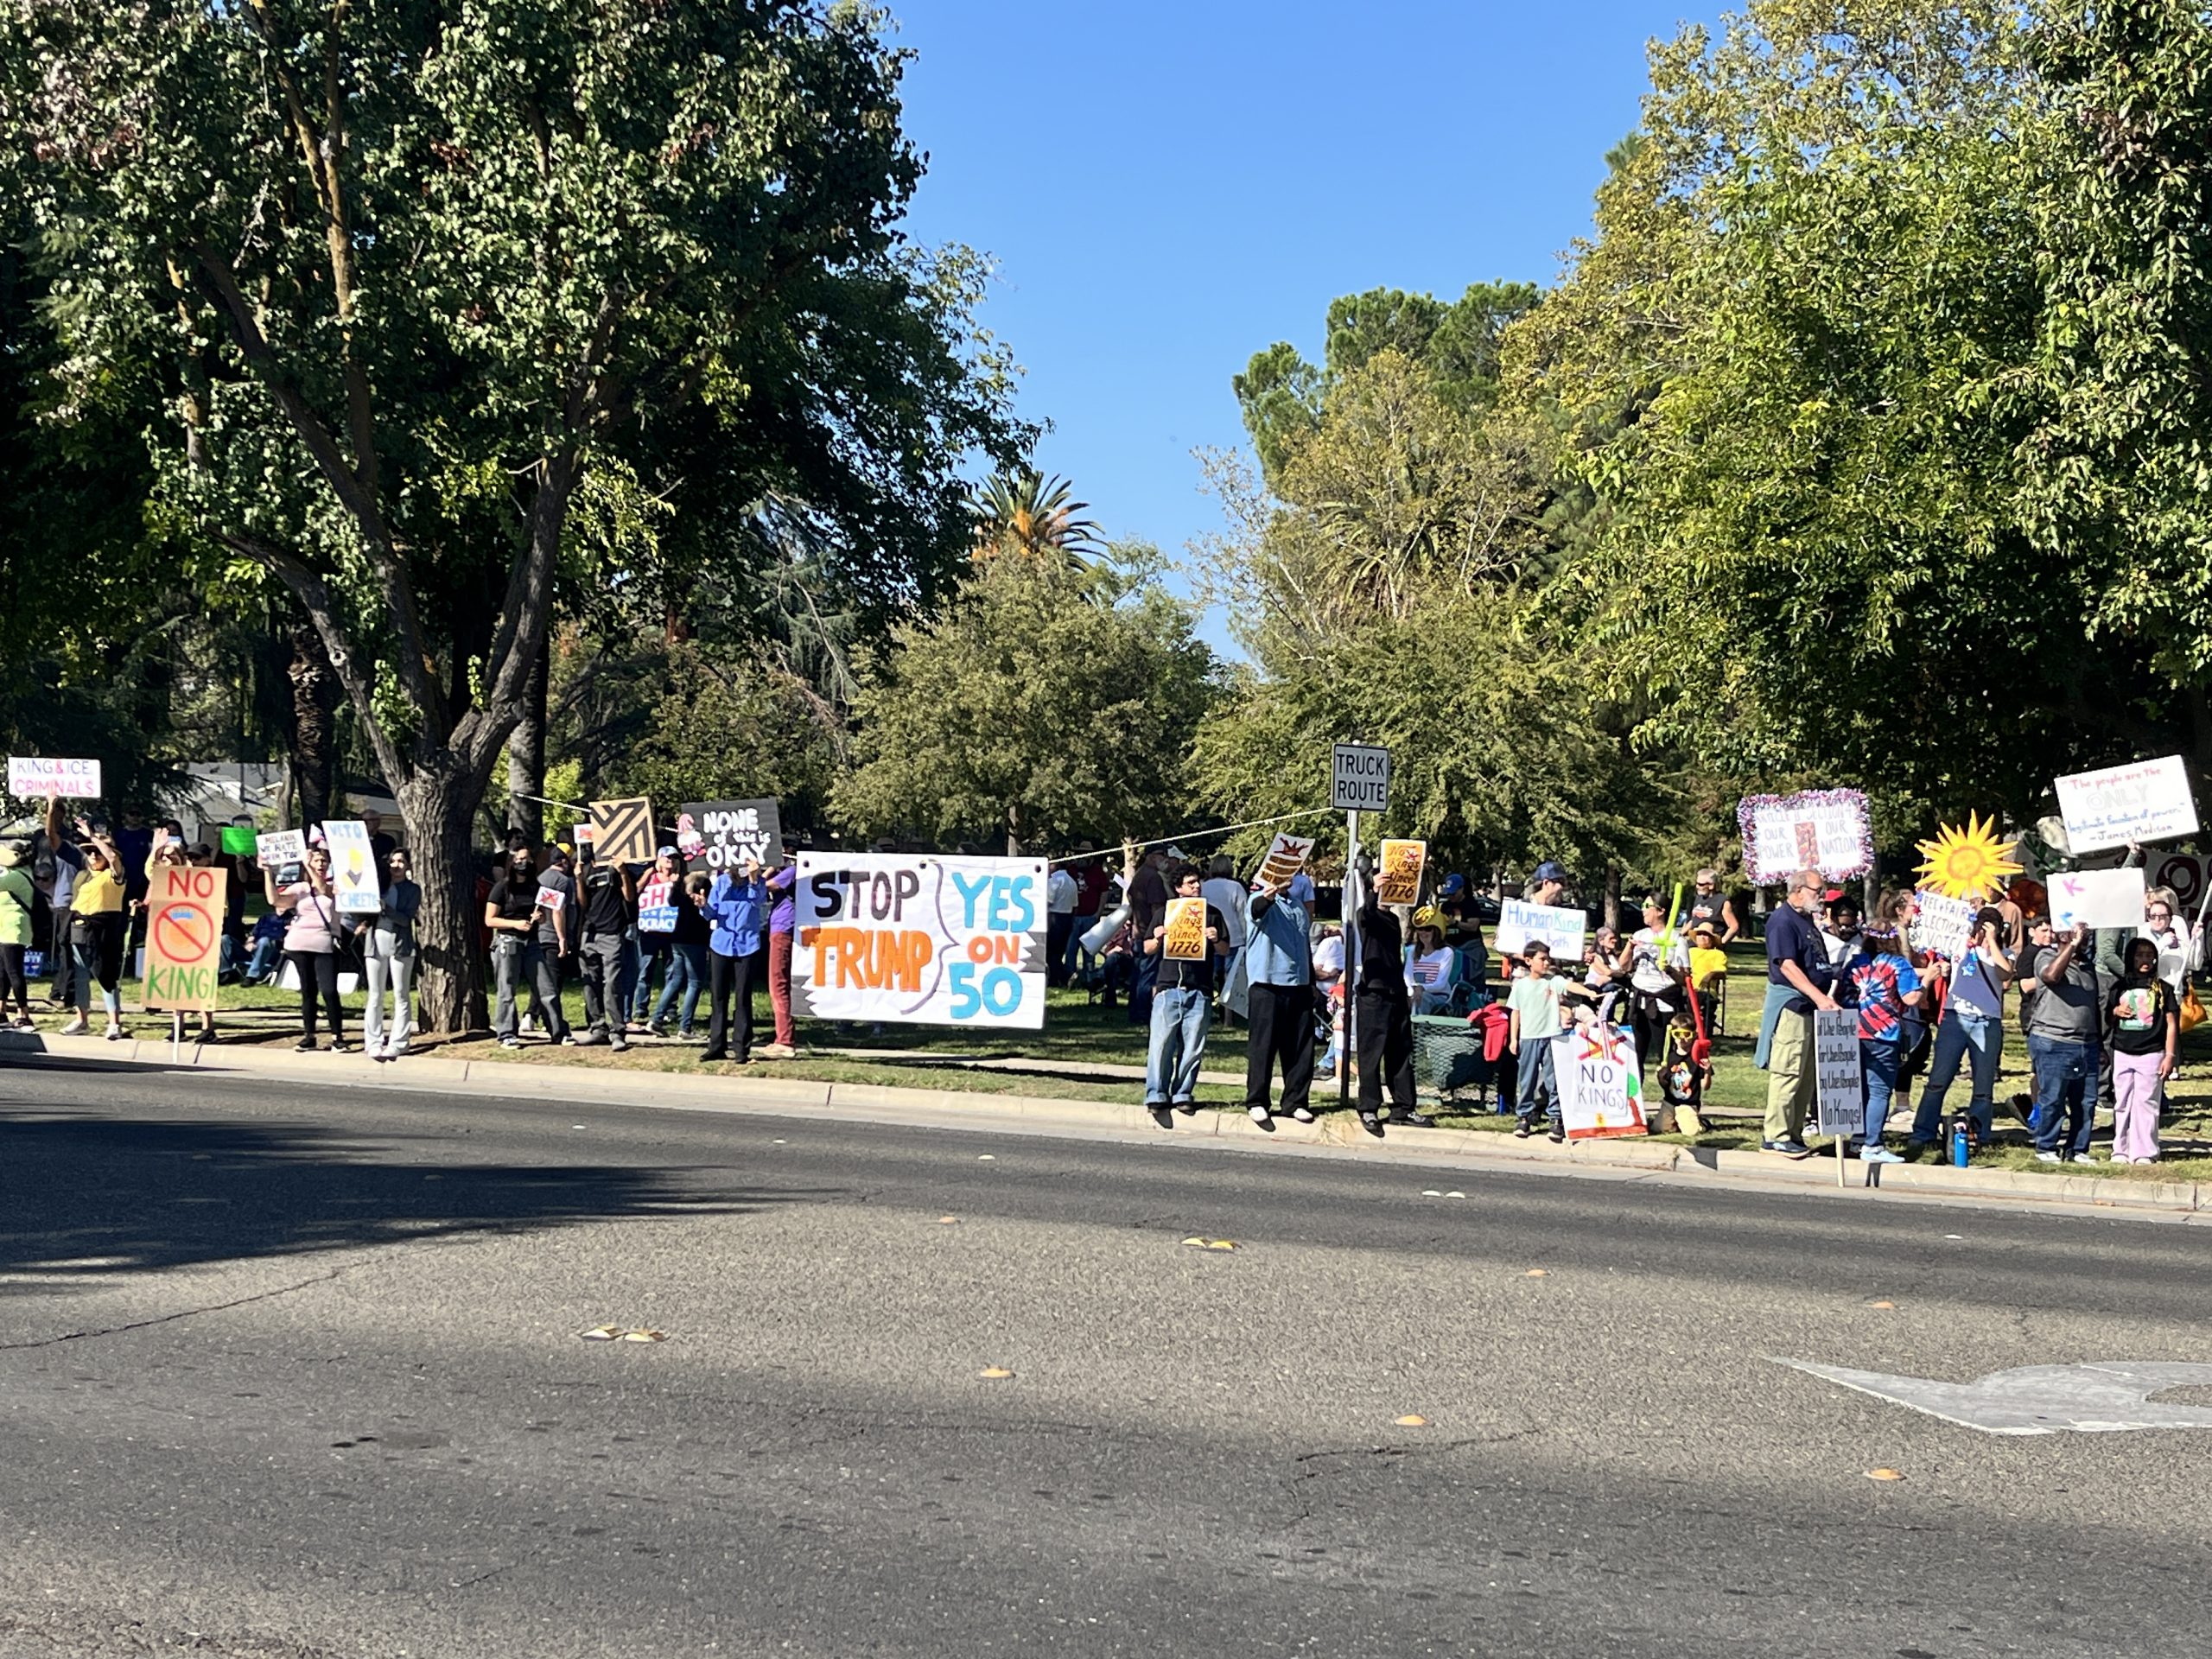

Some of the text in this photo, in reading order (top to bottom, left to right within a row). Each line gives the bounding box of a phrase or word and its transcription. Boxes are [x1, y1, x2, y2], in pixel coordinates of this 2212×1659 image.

[1337, 753, 1385, 777] TRUCK
[2125, 772, 2142, 781] are
[1337, 780, 1385, 803] ROUTE
[2086, 784, 2149, 811] ONLY
[328, 823, 363, 839] VETO
[703, 808, 759, 833] NONE
[1825, 819, 1849, 835] OUR
[714, 831, 727, 847] of
[758, 830, 771, 843] is
[1764, 827, 1788, 841] OUR
[1821, 836, 1858, 855] NATION
[706, 843, 767, 868] OKAY
[168, 869, 214, 899] NO
[810, 868, 920, 922] STOP
[1384, 885, 1417, 899] 1776
[951, 872, 1035, 933] YES
[798, 926, 933, 992] TRUMP
[967, 935, 1020, 964] ON
[1169, 941, 1201, 954] 1776
[949, 962, 1023, 1020] 50
[1581, 1064, 1613, 1084] NO
[1578, 1084, 1624, 1110] KINGS
